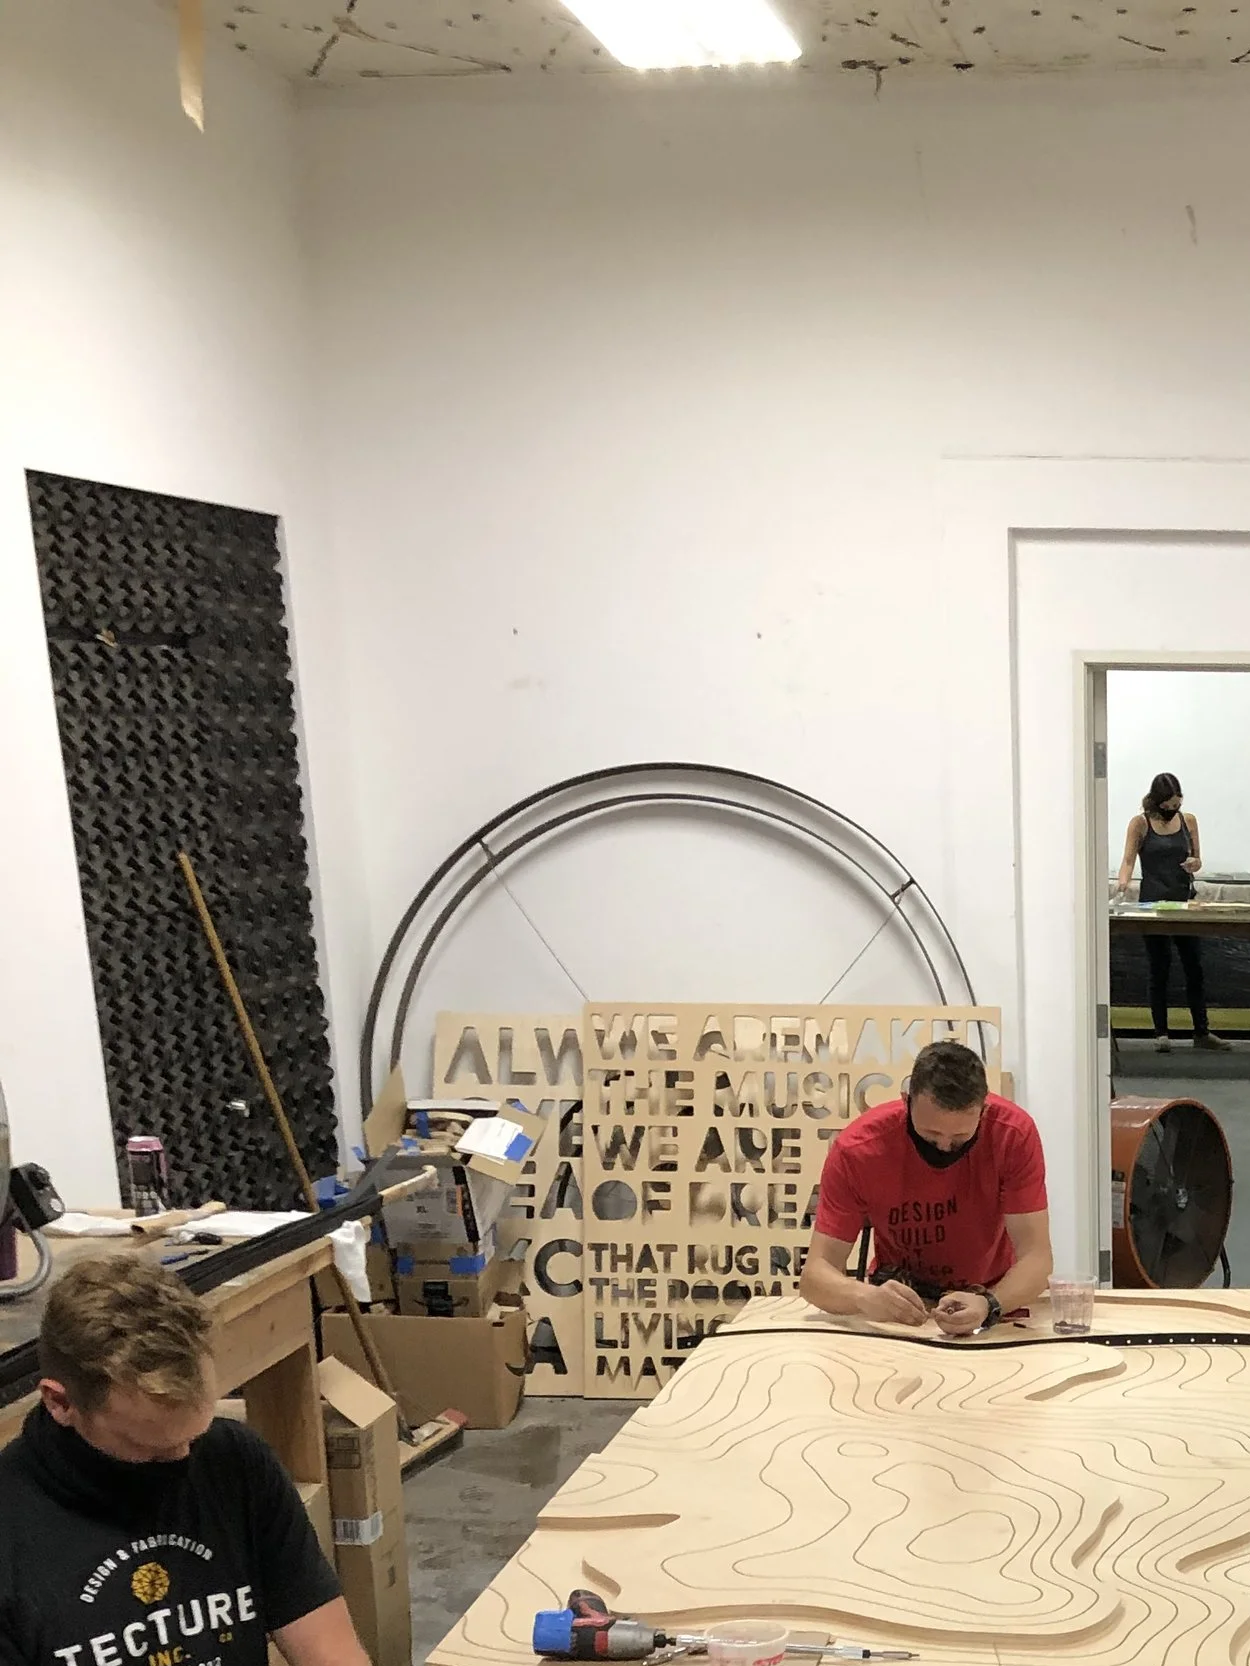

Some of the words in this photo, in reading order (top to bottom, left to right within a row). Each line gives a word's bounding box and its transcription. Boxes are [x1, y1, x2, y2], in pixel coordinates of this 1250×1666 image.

[591, 1013, 679, 1061] WE
[588, 1069, 694, 1117] THE
[591, 1124, 678, 1172] WE
[694, 1126, 801, 1174] ARE
[591, 1180, 671, 1226] OF
[888, 1196, 957, 1226] DESIGN
[587, 1243, 678, 1274] THAT
[687, 1244, 760, 1276] RUG
[588, 1277, 657, 1308] THE
[79, 1557, 118, 1603] DESIGN
[115, 1549, 130, 1561] &
[130, 1533, 213, 1561] FABRICATION
